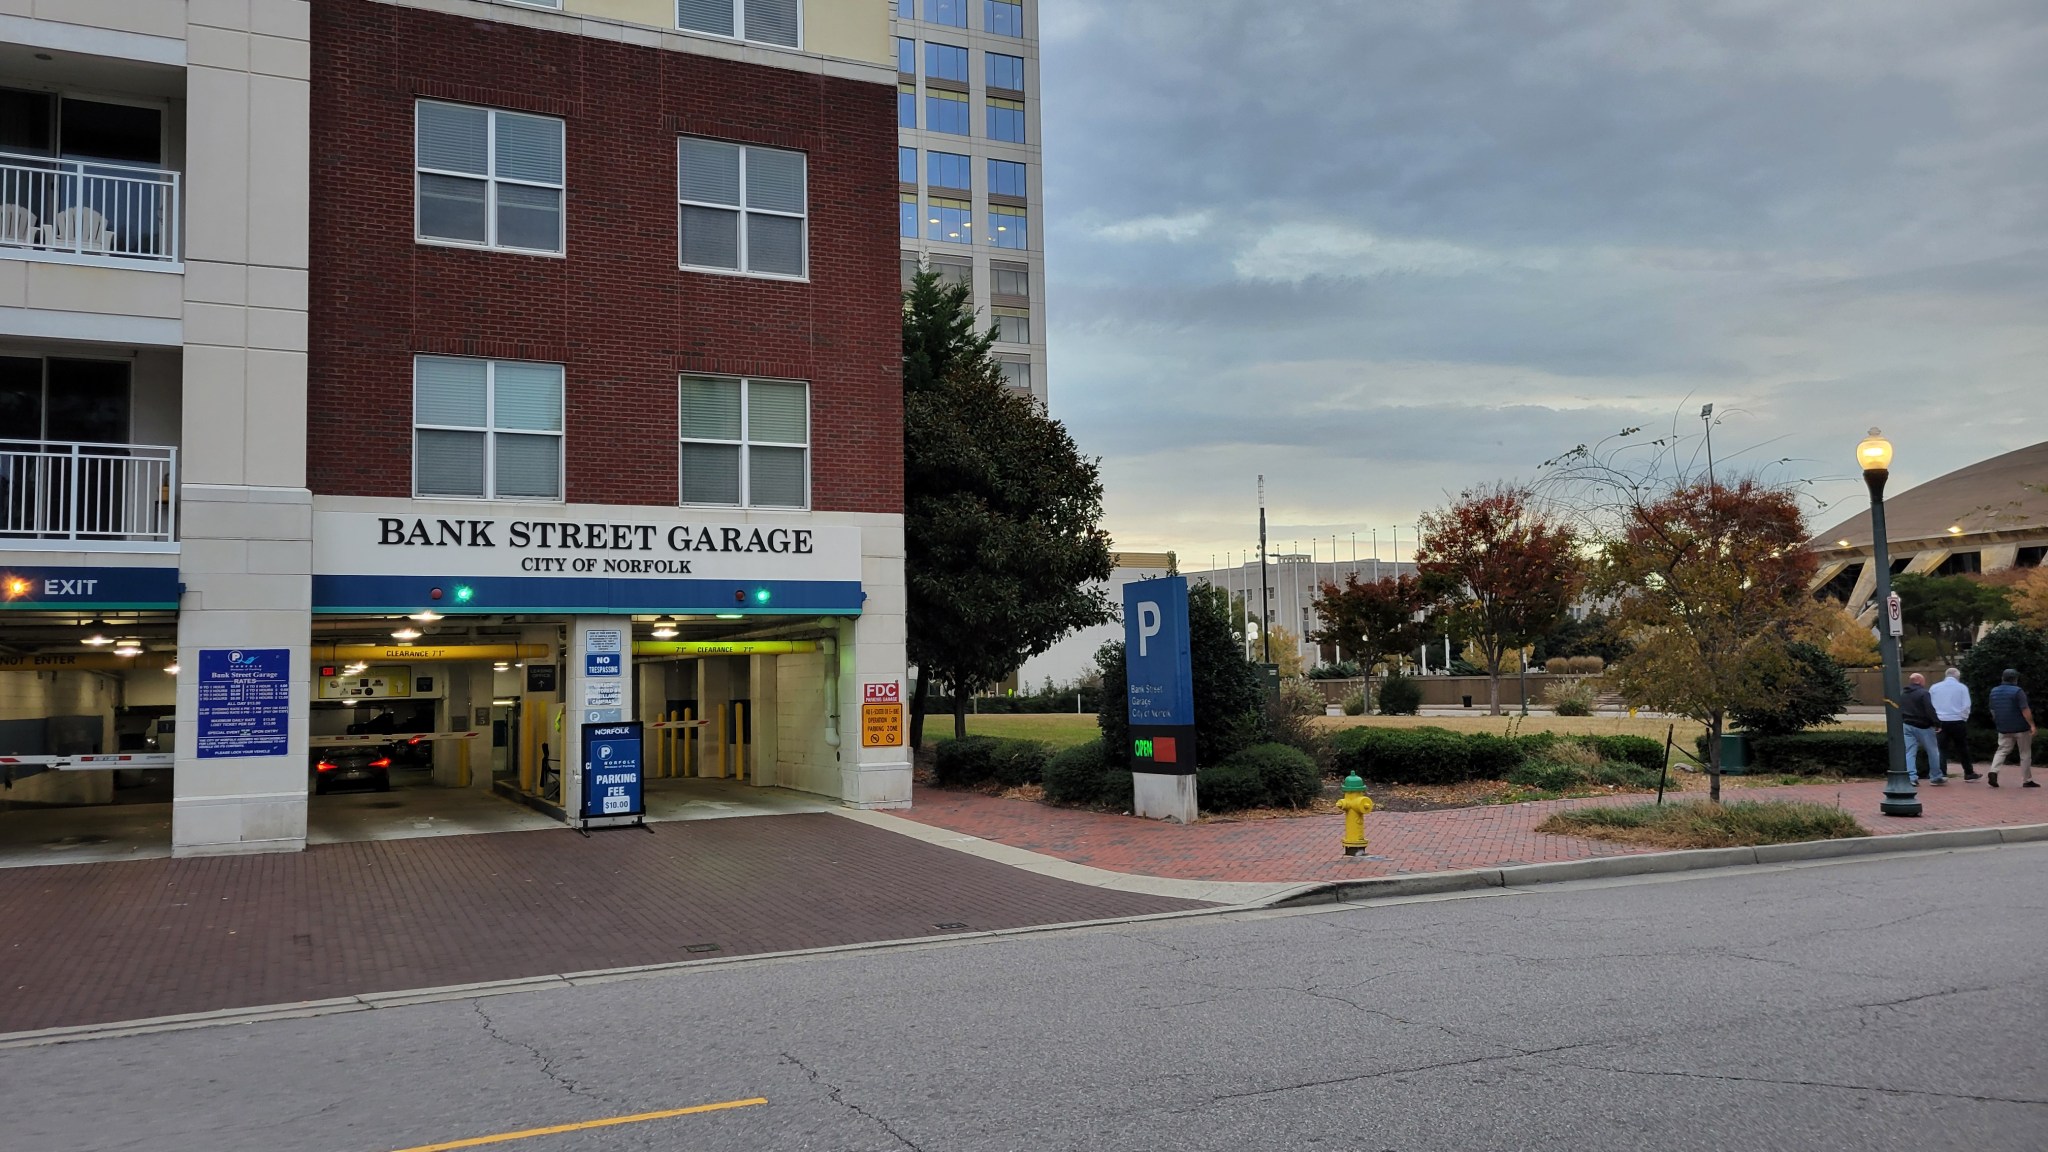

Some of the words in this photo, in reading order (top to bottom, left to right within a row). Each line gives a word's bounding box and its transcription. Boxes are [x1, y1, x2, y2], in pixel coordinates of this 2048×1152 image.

[377, 517, 496, 547] BANK
[509, 521, 657, 550] STREET
[667, 525, 813, 554] GARAGE
[521, 557, 567, 572] CITY
[572, 557, 597, 572] OF
[602, 558, 692, 574] NORFOLK
[44, 579, 98, 595] EXIT
[1137, 601, 1161, 657] P
[0, 655, 25, 666] NOT
[34, 655, 76, 665] ENTER
[866, 684, 896, 697] FDC
[1131, 684, 1144, 694] Bank
[1146, 684, 1162, 694] Street
[1131, 697, 1152, 707] Garage
[1132, 708, 1143, 719] City
[600, 746, 611, 758] P
[1134, 740, 1153, 757] OPEN
[596, 773, 637, 785] PARKING
[608, 786, 625, 796] FEE
[605, 801, 628, 809] $10.00
